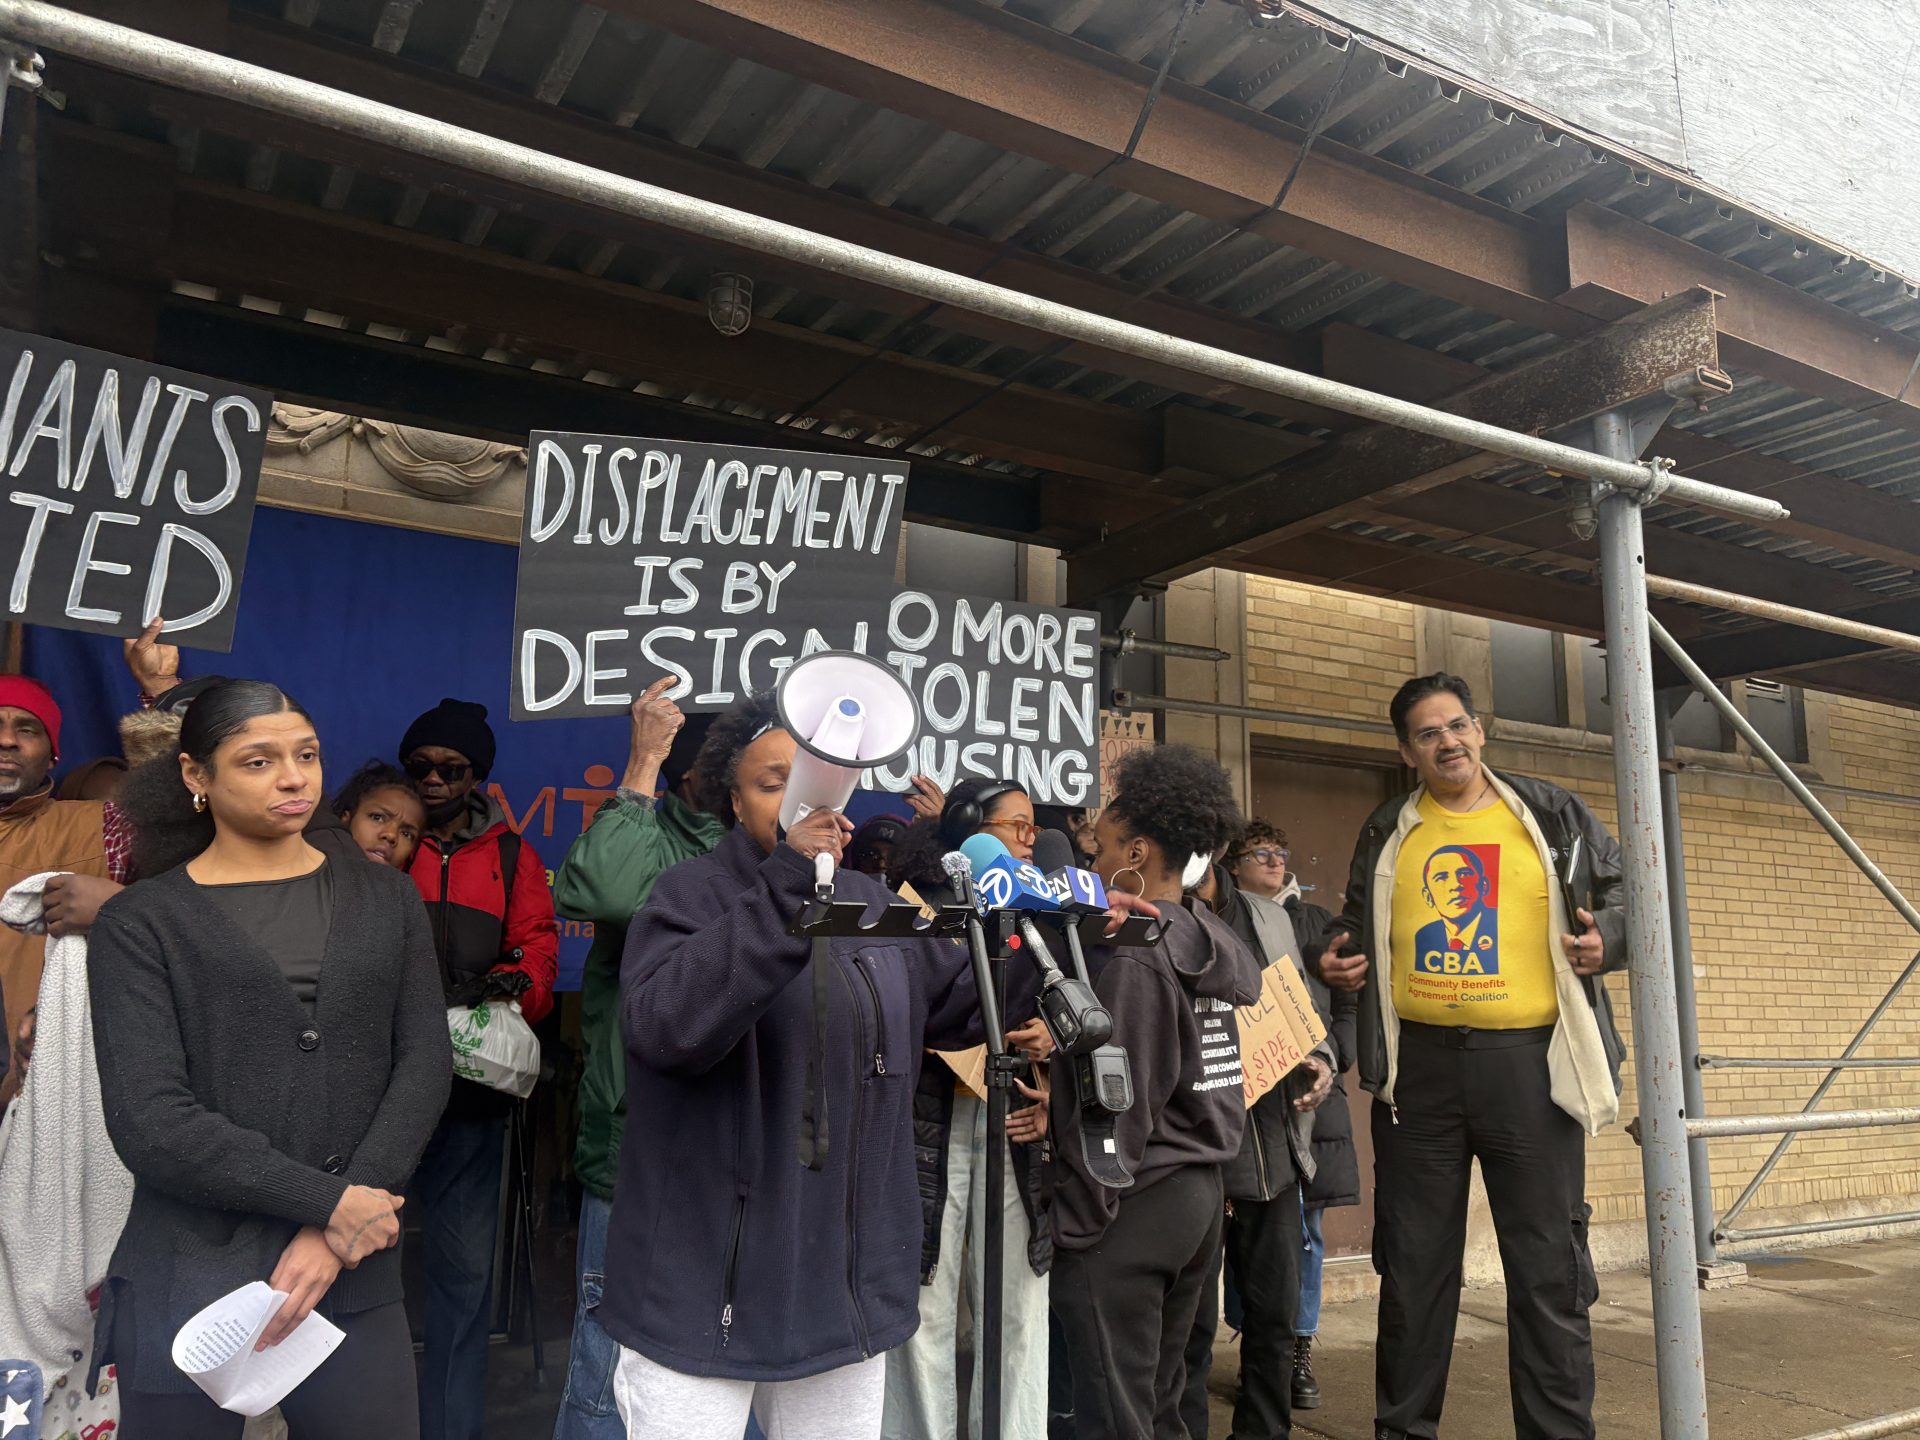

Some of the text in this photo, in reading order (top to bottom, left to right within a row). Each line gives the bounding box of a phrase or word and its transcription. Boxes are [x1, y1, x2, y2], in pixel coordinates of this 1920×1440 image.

[530, 439, 905, 554] DISPLACEMENT
[9, 491, 233, 633] TED
[624, 556, 796, 615] IS BY
[954, 598, 1096, 679] MORE
[860, 735, 1094, 806] OUSING
[1076, 868, 1096, 906] 9
[1408, 974, 1506, 991] Community Benefits
[1424, 950, 1486, 974] CBA
[1408, 986, 1509, 1002] Agreement Coalition
[1252, 1031, 1289, 1070] SIDE
